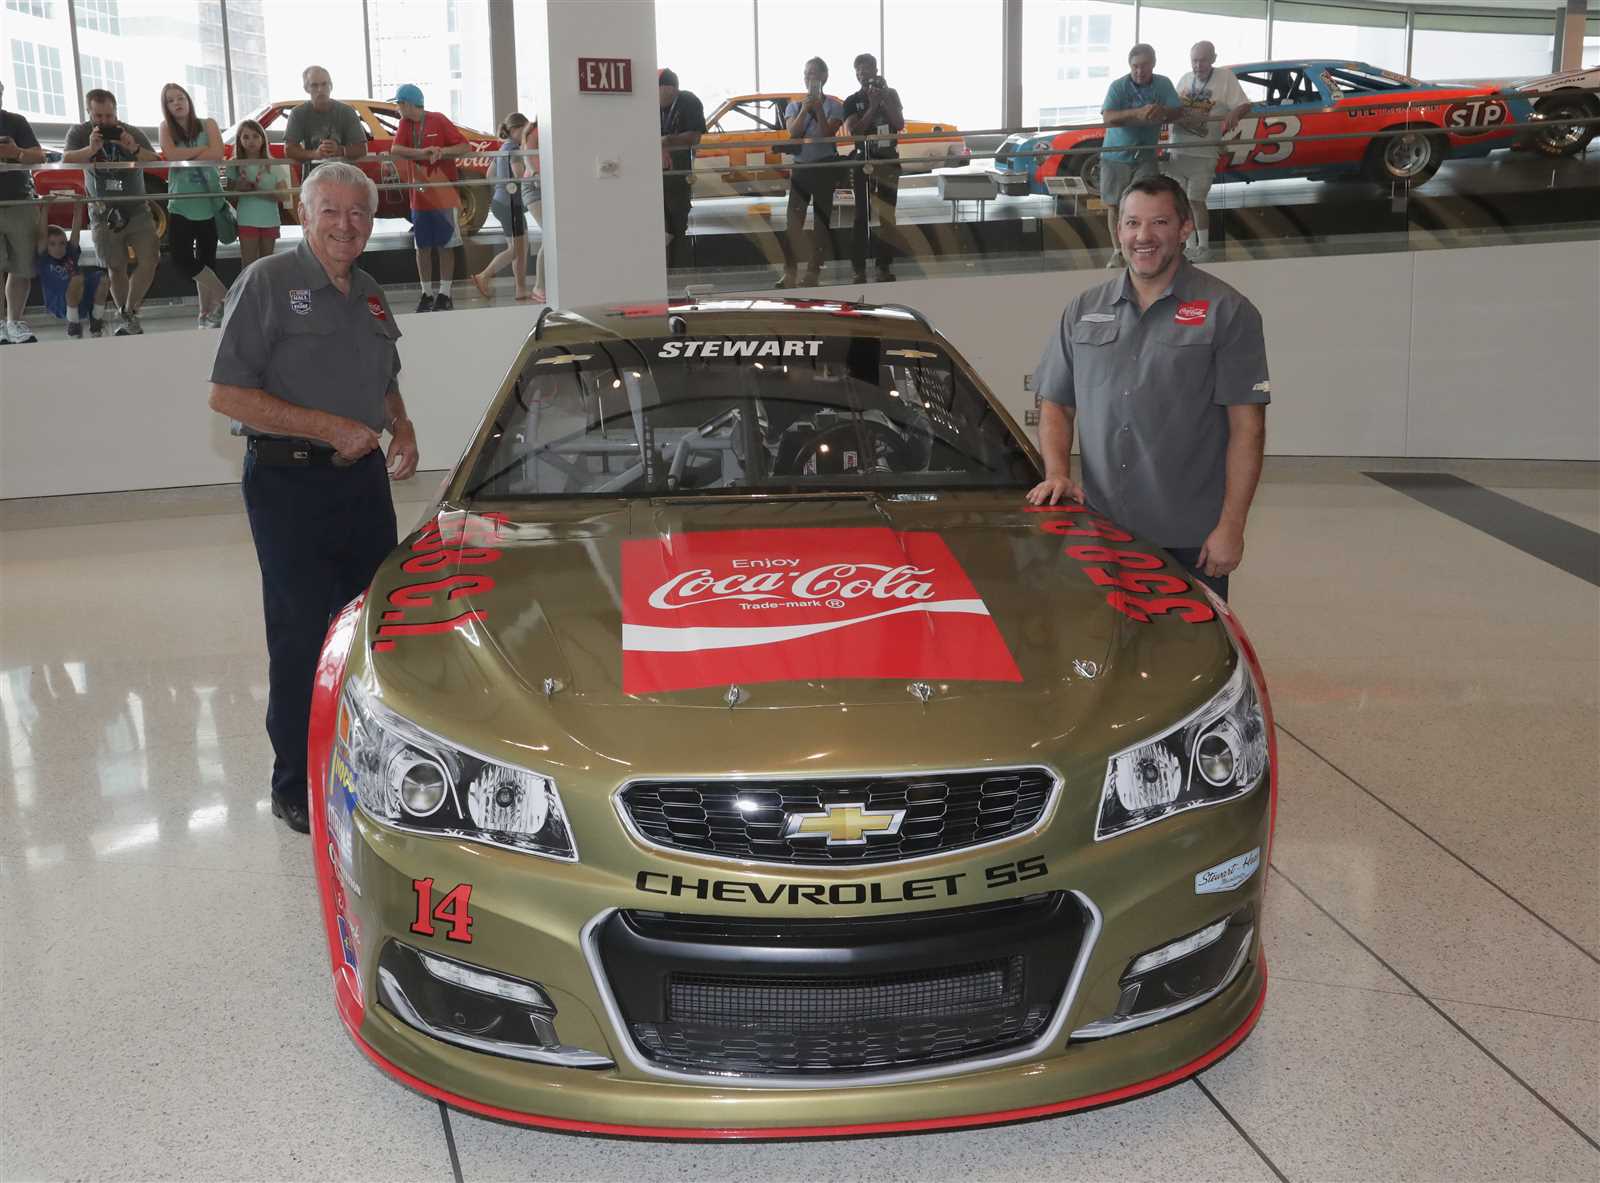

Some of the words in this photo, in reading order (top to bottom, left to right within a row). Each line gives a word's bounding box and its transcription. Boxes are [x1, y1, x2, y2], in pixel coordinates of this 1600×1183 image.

[586, 62, 626, 89] EXIT
[1221, 115, 1301, 166] 43
[657, 339, 824, 359] STEWART
[648, 563, 936, 610] Coca-Cola
[732, 557, 801, 569] Enjoy
[1062, 545, 1217, 625] 358
[739, 600, 822, 611] Trade-mark
[635, 871, 967, 906] CHEVROLET
[984, 854, 1050, 889] SS
[410, 877, 473, 944] 14
